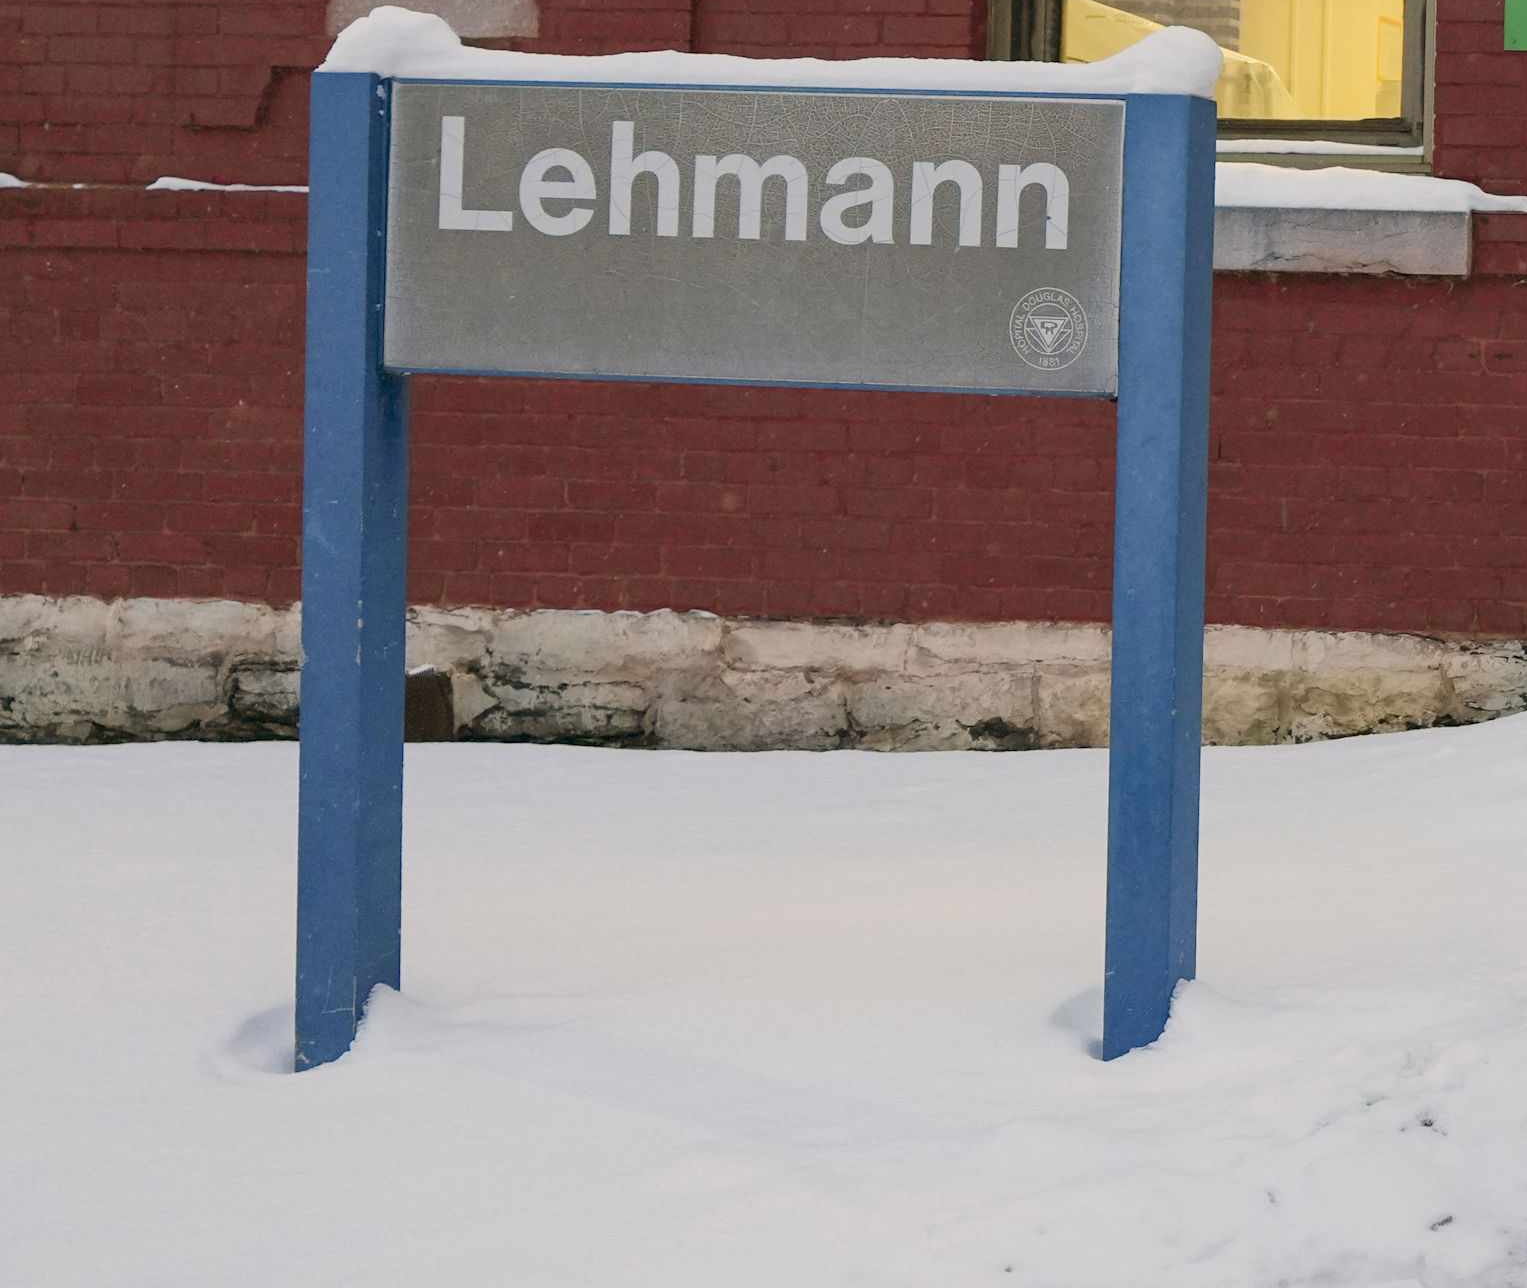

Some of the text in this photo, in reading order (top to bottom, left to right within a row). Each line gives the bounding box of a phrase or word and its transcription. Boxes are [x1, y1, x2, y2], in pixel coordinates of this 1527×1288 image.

[438, 115, 1071, 250] Lehmann
[1022, 292, 1070, 311] DOUGLAS
[1066, 306, 1083, 354] HOSPITAL
[1039, 357, 1060, 367] 1881
